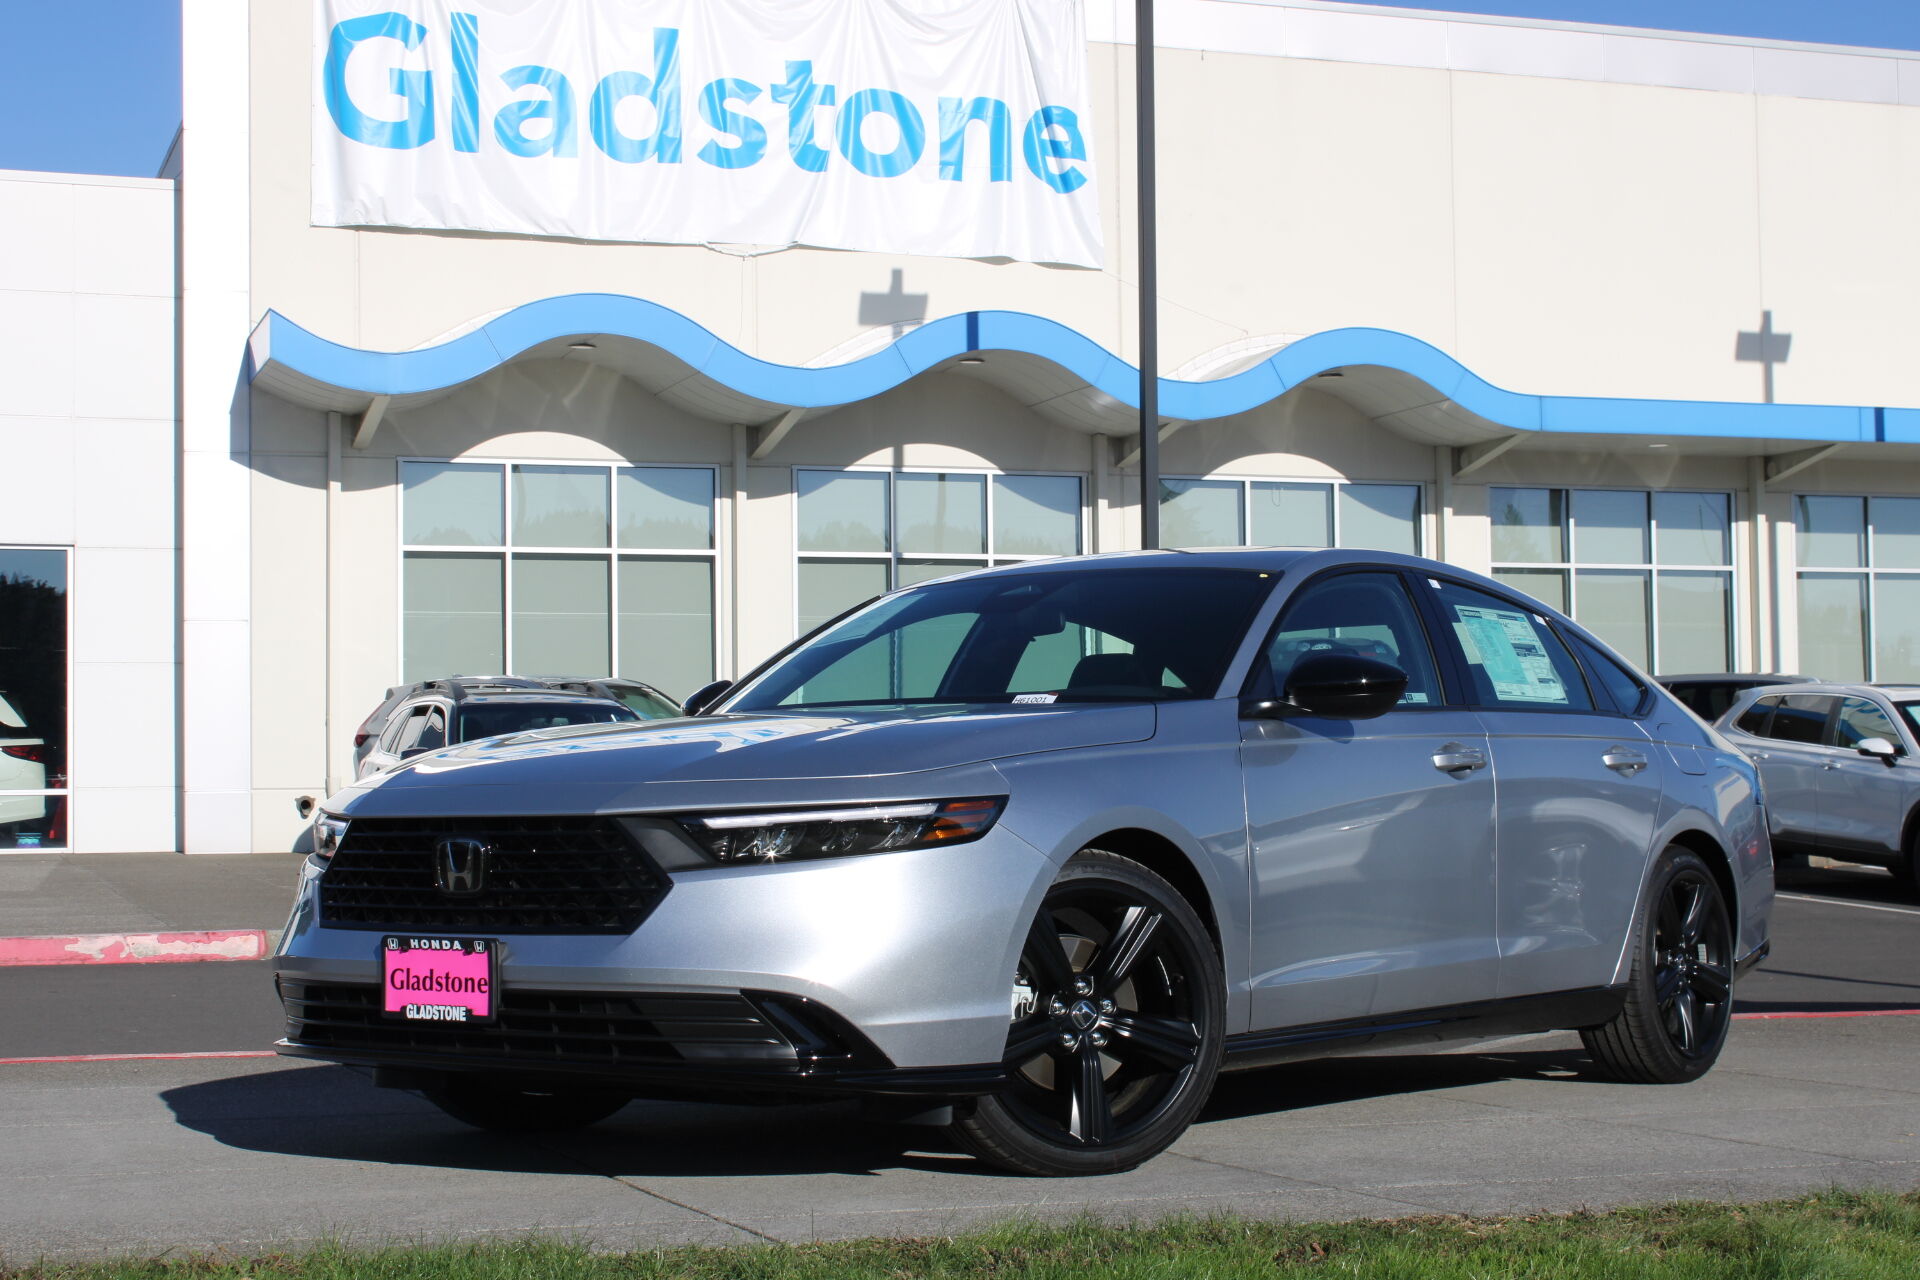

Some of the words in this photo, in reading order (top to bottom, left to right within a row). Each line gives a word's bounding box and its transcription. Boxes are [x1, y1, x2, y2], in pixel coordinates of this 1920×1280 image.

[322, 10, 1088, 195] Gladstone
[409, 938, 462, 950] HONDA
[390, 967, 489, 994] Gladstone
[406, 1003, 467, 1021] GLADSTONE
